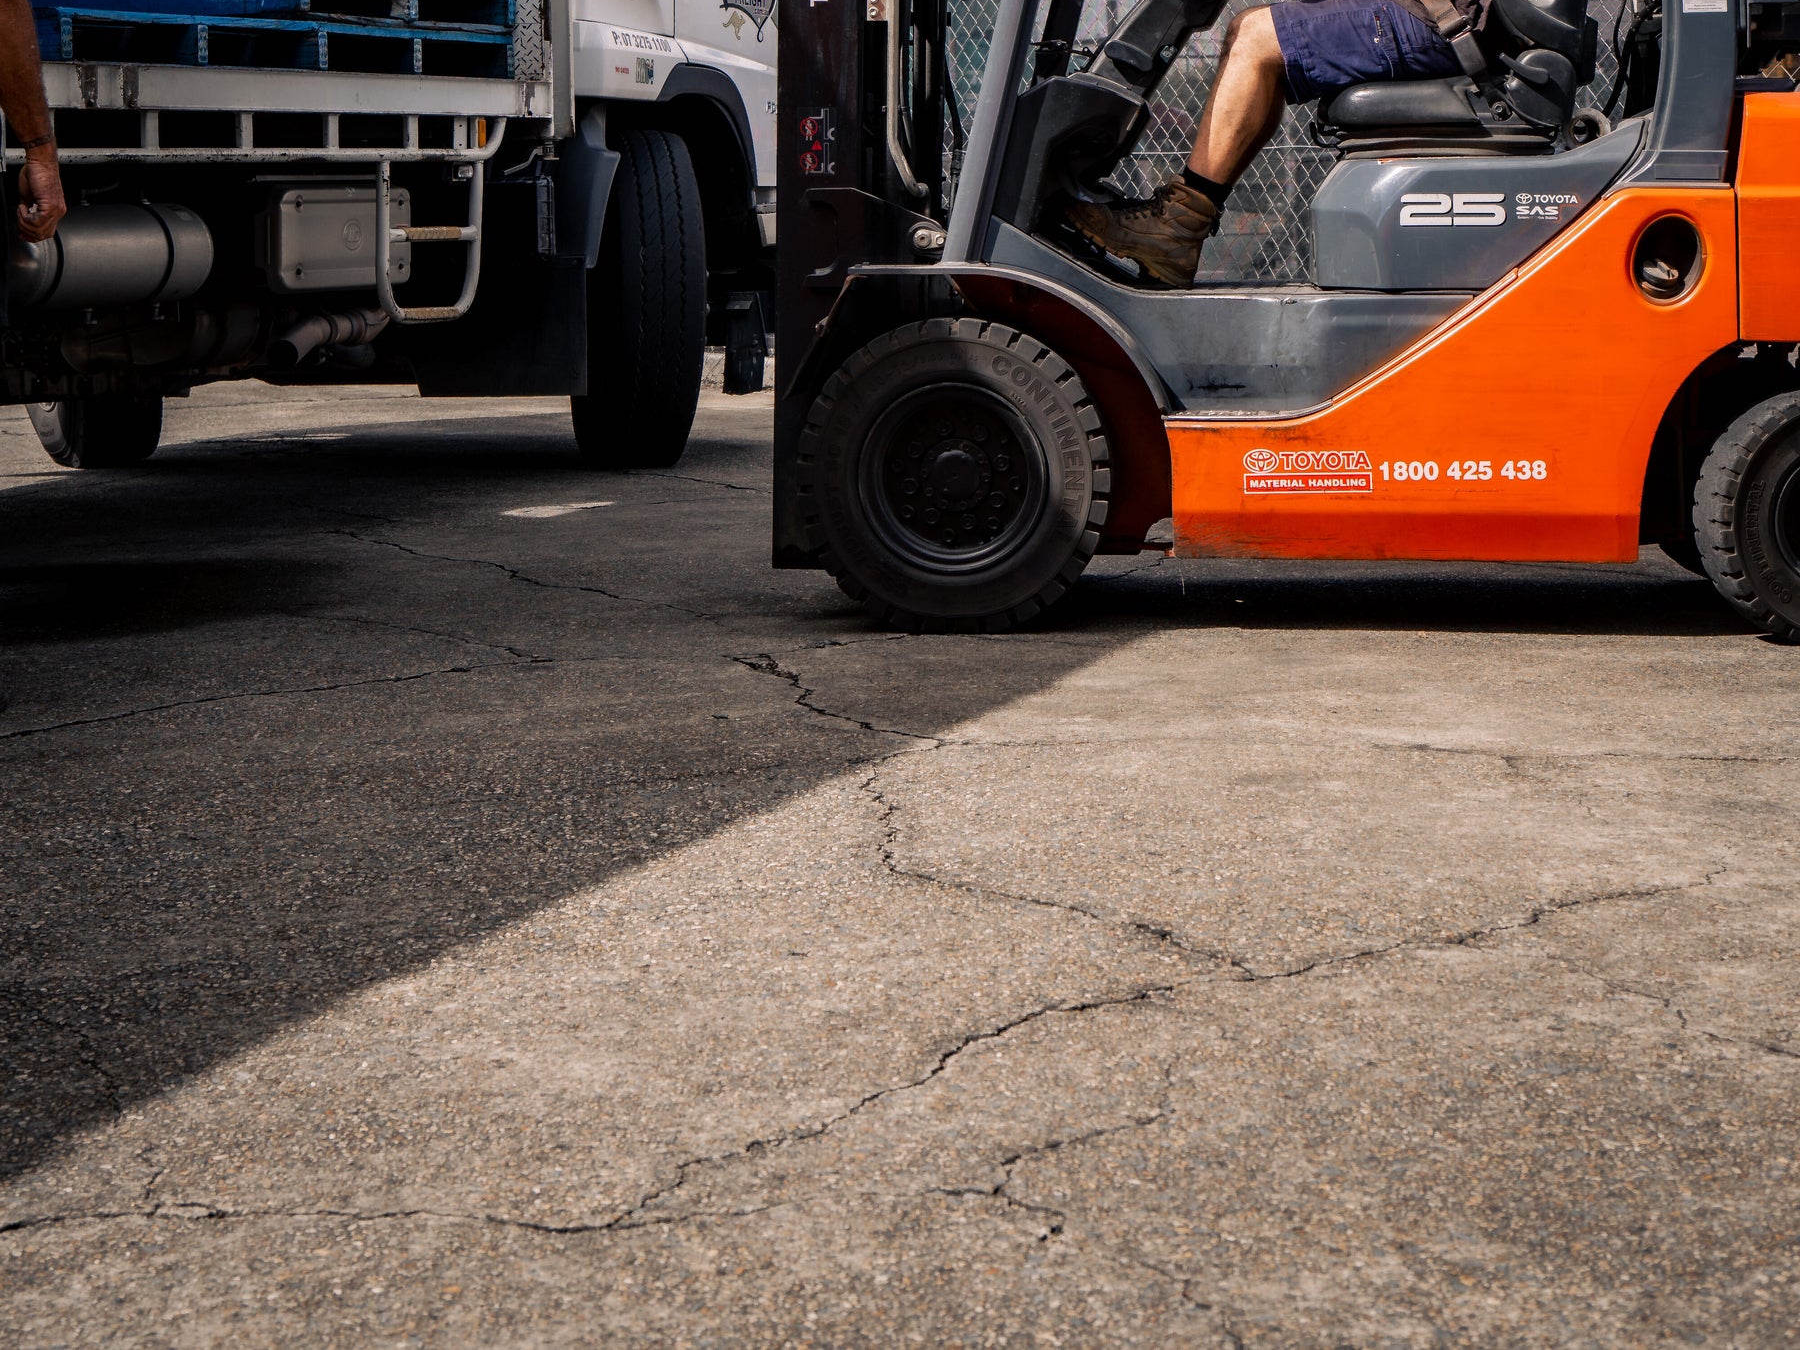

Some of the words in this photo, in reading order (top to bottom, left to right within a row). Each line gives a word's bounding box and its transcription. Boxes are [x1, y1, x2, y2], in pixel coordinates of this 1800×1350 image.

[611, 31, 622, 46] P:
[621, 33, 632, 47] 07
[1400, 193, 1507, 226] 25
[1515, 205, 1559, 215] SAS
[1534, 194, 1578, 204] TOYOTA
[991, 354, 1085, 537] CONTINENTA
[1279, 451, 1373, 471] TOYOTA
[1379, 461, 1439, 481] 1800
[1446, 461, 1493, 481] 425
[1500, 460, 1548, 480] 438
[1250, 478, 1306, 488] MATERIAL
[1308, 477, 1367, 488] HANDLING
[1745, 479, 1792, 604] CONTINENTAL
